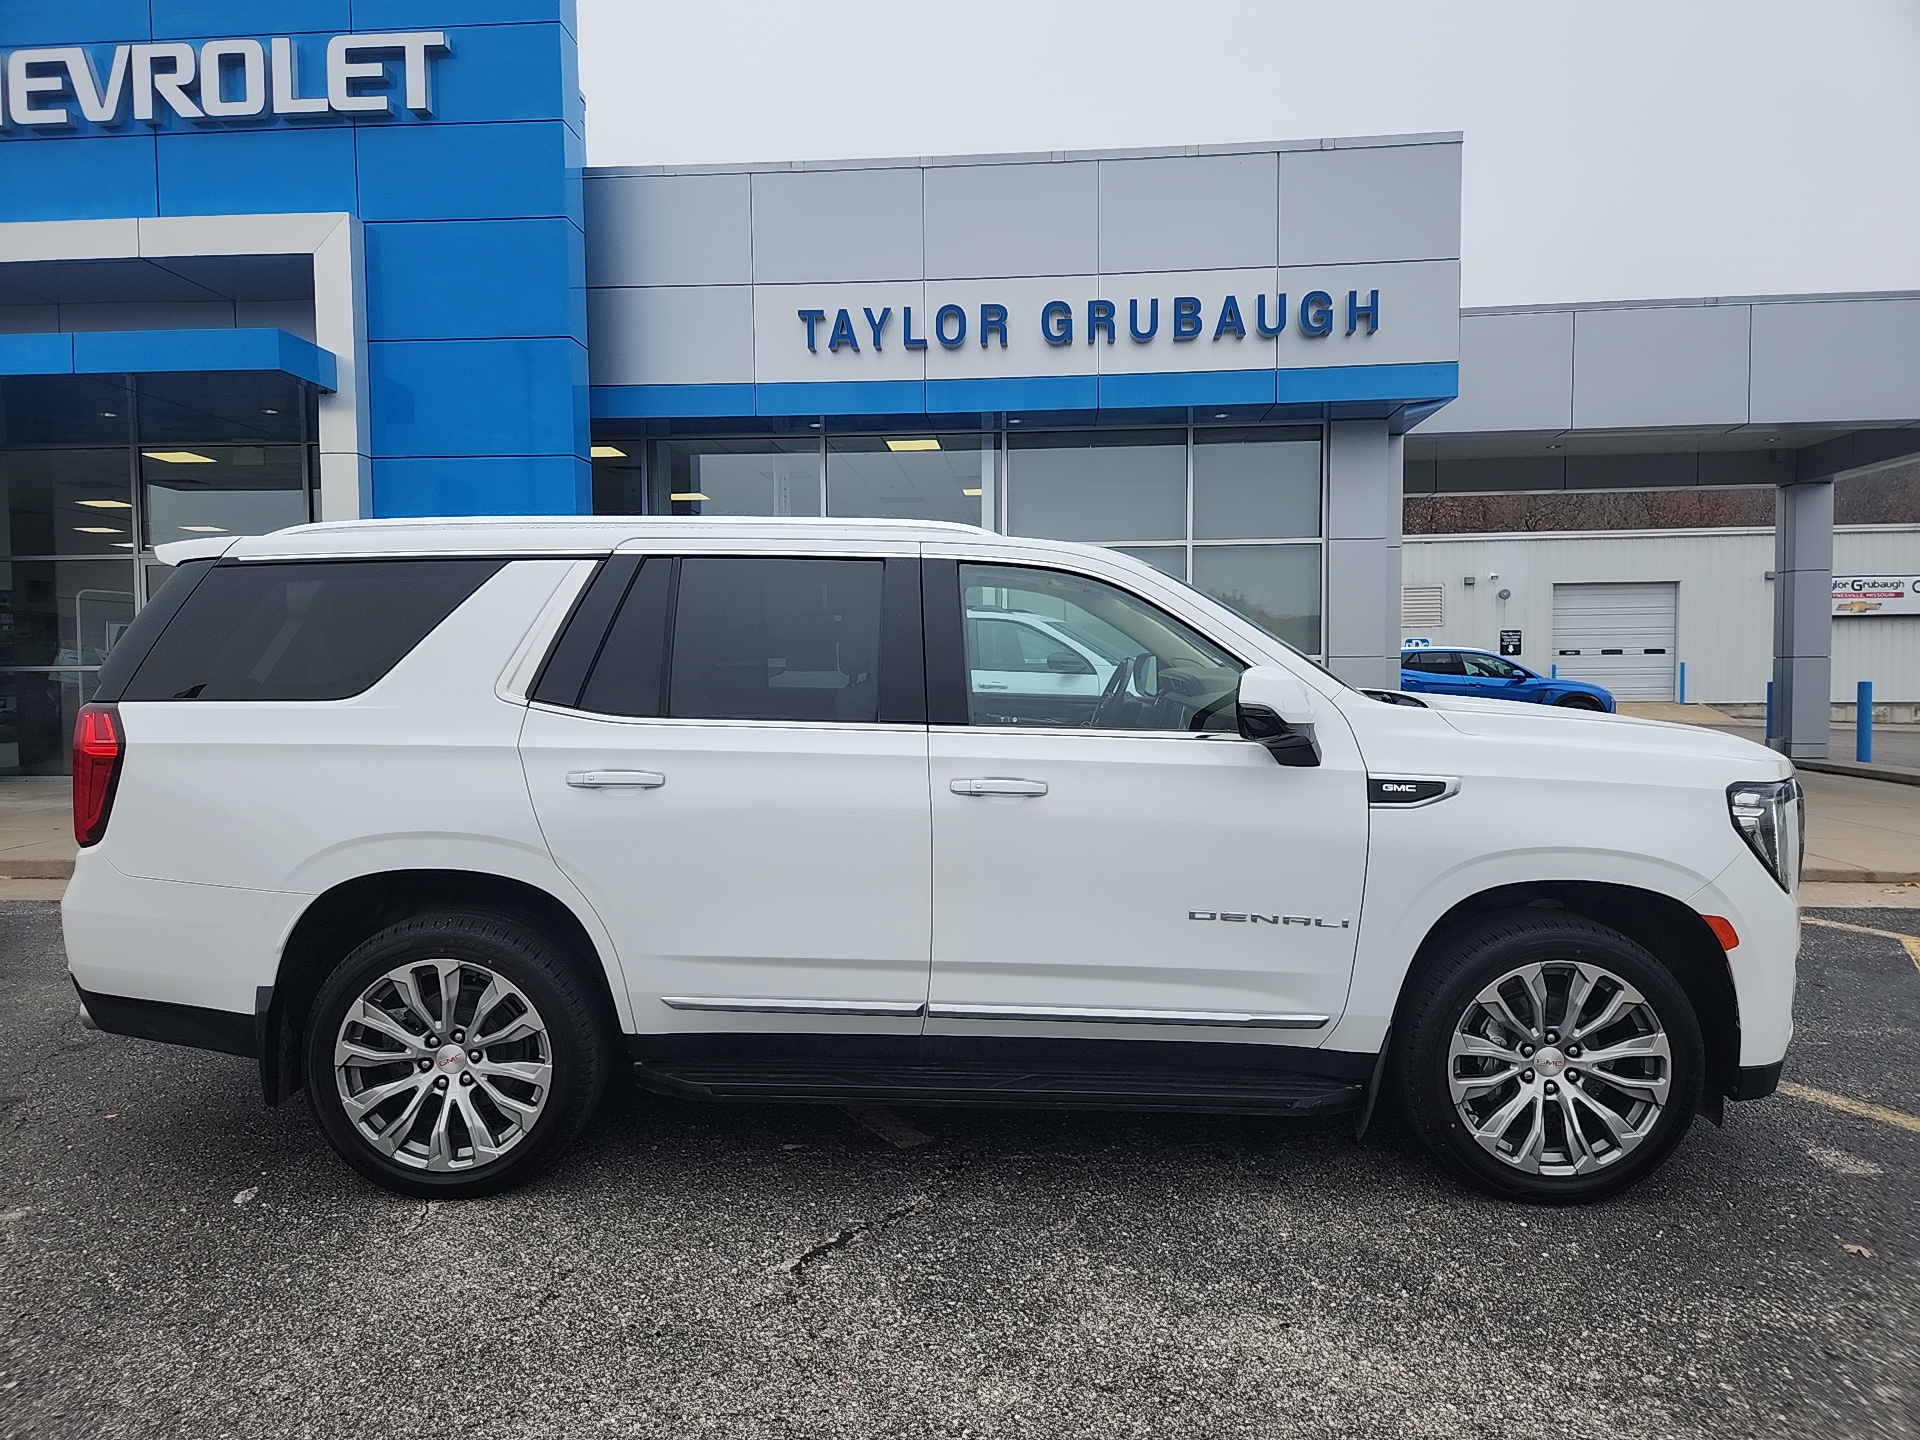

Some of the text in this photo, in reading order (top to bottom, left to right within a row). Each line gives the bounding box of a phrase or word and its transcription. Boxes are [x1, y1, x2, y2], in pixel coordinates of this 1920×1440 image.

[0, 31, 447, 128] EVROLET
[798, 289, 1380, 351] TAYLOR GRUBAUGH
[1851, 579, 1904, 591] Grubaugh
[1382, 783, 1417, 792] GMC
[1188, 908, 1350, 928] DENALI
[438, 1052, 464, 1066] GMC
[1536, 1058, 1563, 1067] GMC
